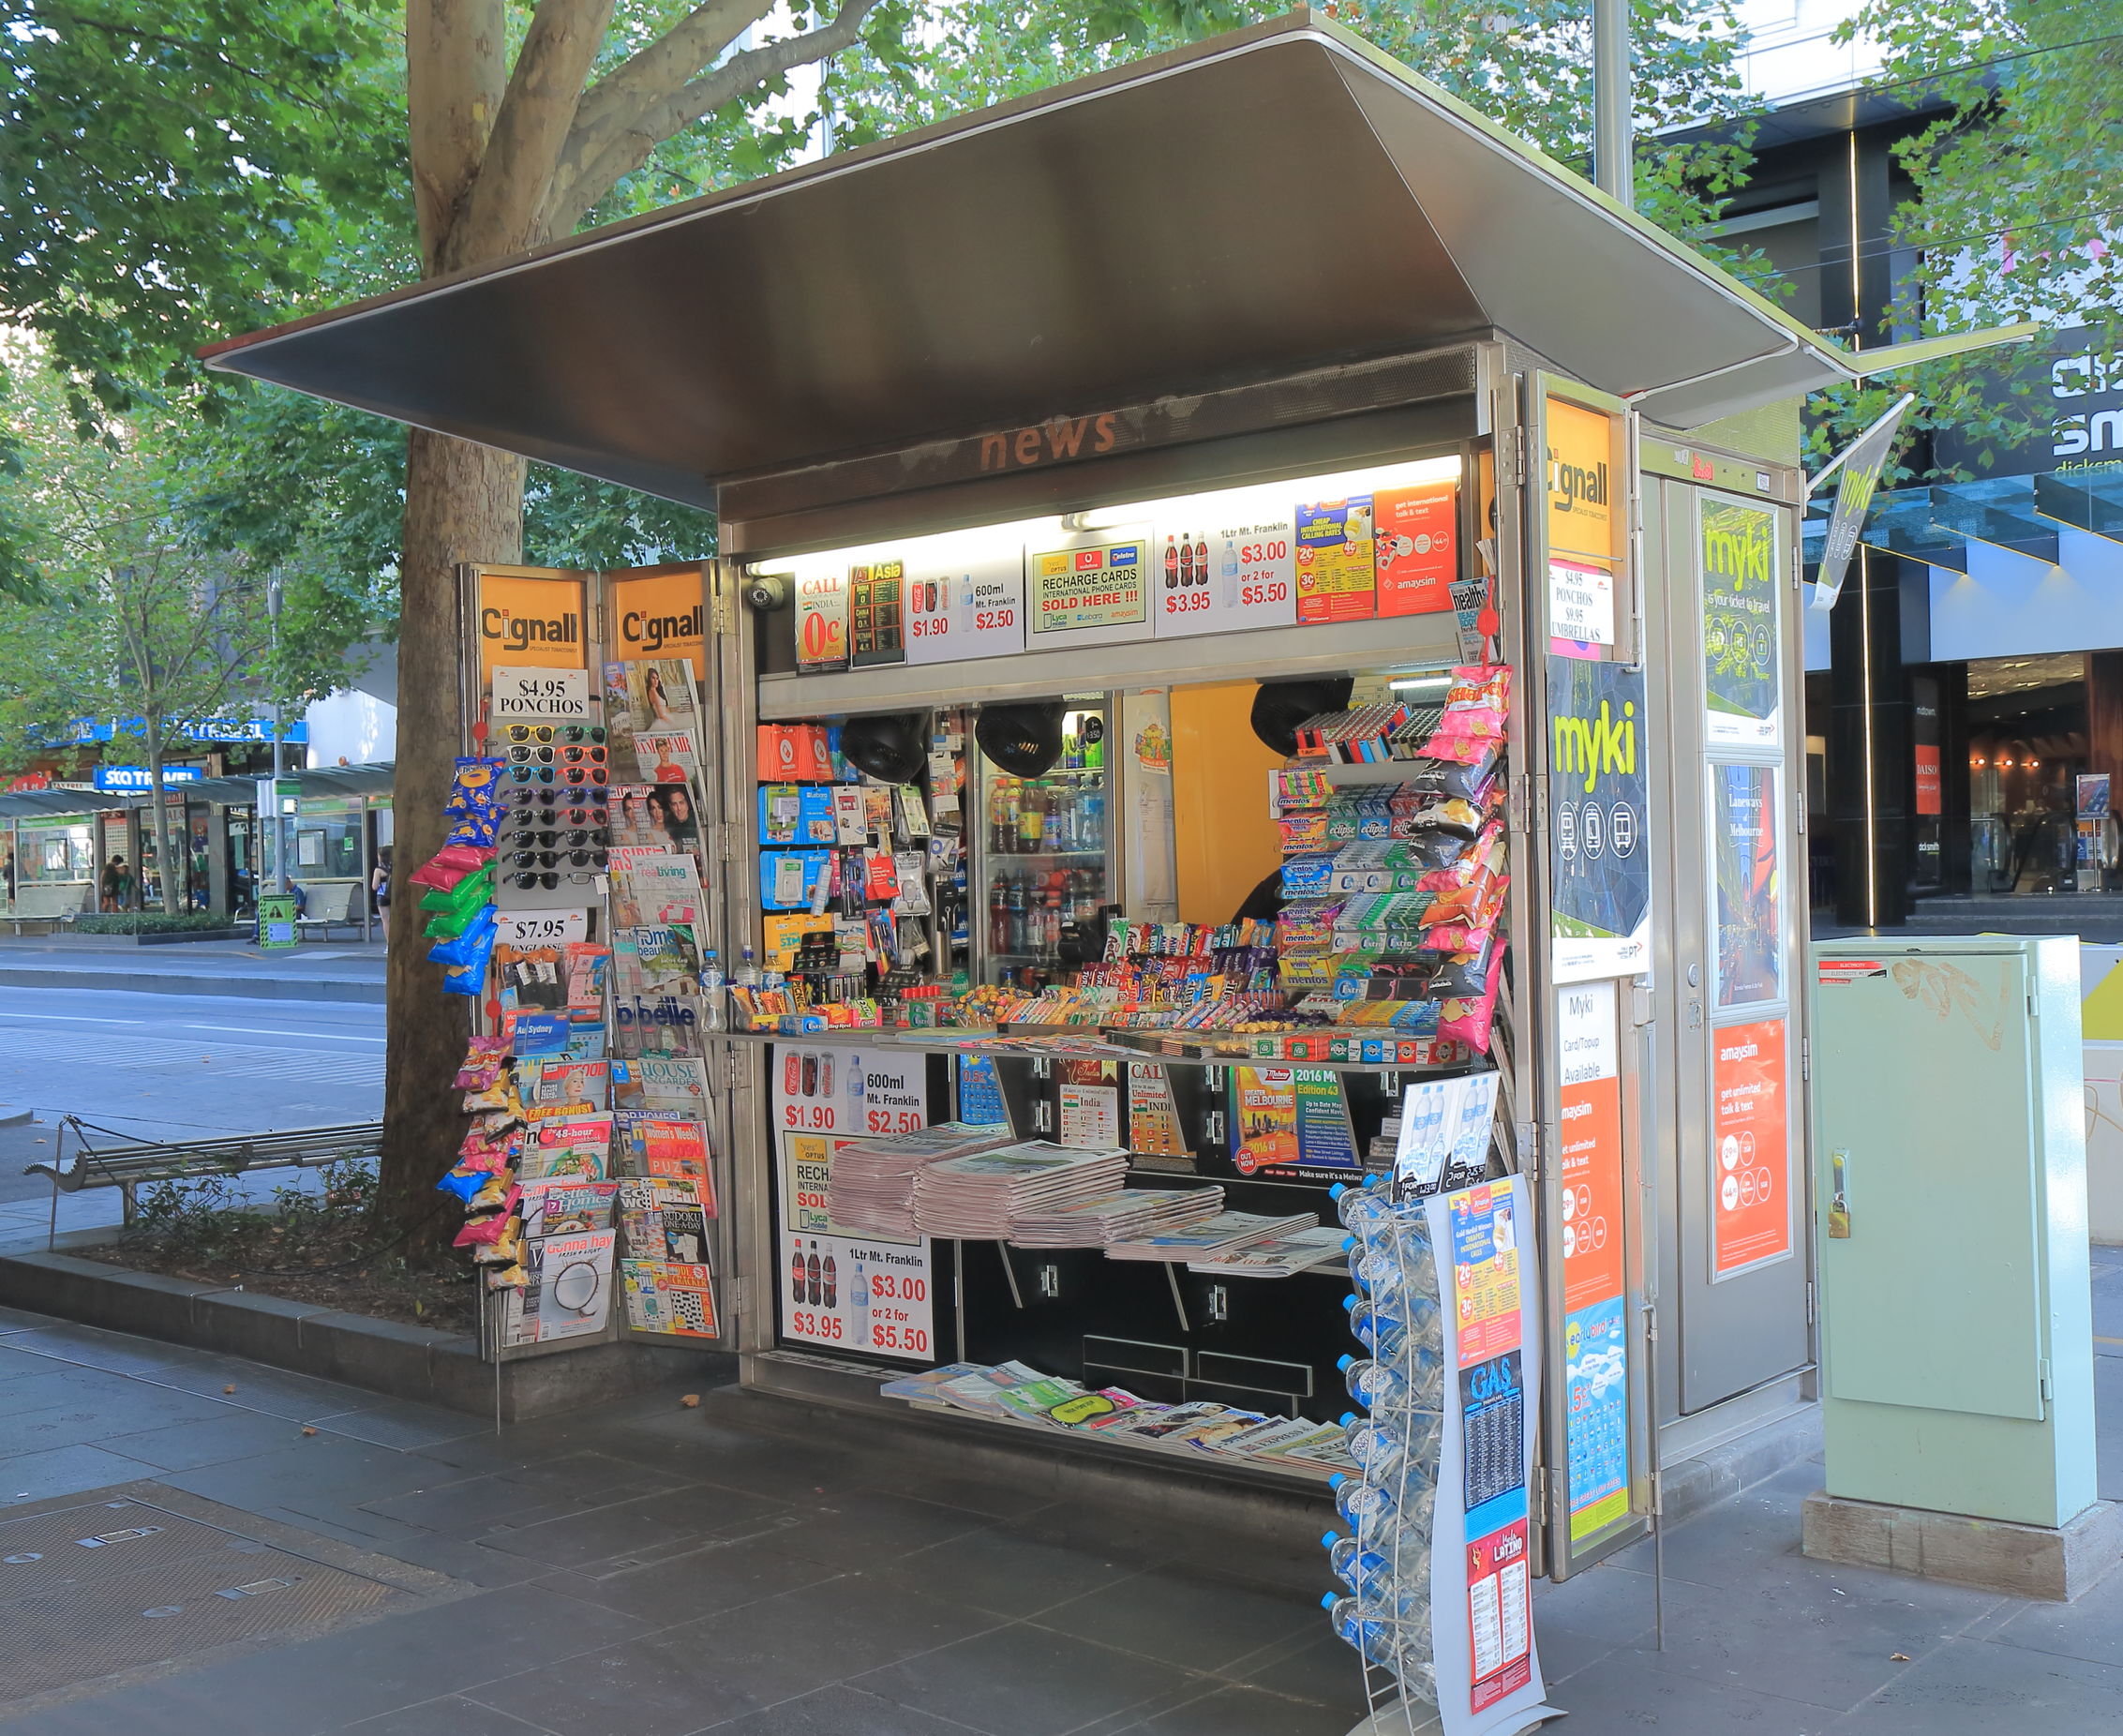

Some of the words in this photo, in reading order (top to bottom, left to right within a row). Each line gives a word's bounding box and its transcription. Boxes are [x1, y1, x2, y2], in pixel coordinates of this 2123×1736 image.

[980, 413, 1116, 471] news
[1407, 495, 1448, 507] international
[1300, 522, 1342, 533] INTERNATIONAL
[1312, 516, 1331, 526] CHEAP
[1220, 530, 1237, 540] 1Ltr
[1239, 527, 1252, 536] Mt.
[1253, 522, 1288, 533] Franklin
[1301, 531, 1324, 540] CALLING
[1324, 529, 1341, 537] RATES
[1241, 540, 1287, 566] $3.00
[1706, 522, 1769, 591] myki
[875, 563, 901, 581] Asia
[1042, 573, 1099, 591] RECHARGE
[1100, 568, 1137, 584] CARDS
[1241, 574, 1251, 582] or
[1253, 571, 1260, 581] 2
[1261, 570, 1275, 580] for
[1565, 569, 1583, 586] $4.95
[802, 576, 842, 595] CALL
[976, 583, 1005, 596] 600ml
[1042, 587, 1090, 599] INTERNATIONAL
[1091, 584, 1114, 593] PHONE
[1114, 581, 1137, 591] CARDS
[1397, 576, 1436, 590] amaysim
[1241, 581, 1287, 606] $5.50
[1556, 587, 1593, 606] PONCHOS
[812, 600, 834, 610] INDIA
[976, 599, 987, 608] Mt.
[988, 597, 1016, 606] Franklin
[1042, 598, 1079, 612] SOLD
[1083, 593, 1121, 607] HERE
[1166, 591, 1211, 615] $3.95
[976, 609, 1014, 631] $2.50
[1565, 606, 1584, 622] $9.95
[482, 607, 577, 651] Cignall
[622, 605, 704, 651] Cignall
[912, 617, 949, 637] $1.90
[1551, 621, 1601, 642] UMBRELLAS
[518, 679, 566, 697] $4.95
[500, 697, 583, 714] PONCHOS
[1554, 699, 1635, 794] myki
[1917, 764, 1937, 774] DAISO
[133, 771, 193, 786] TRVEL
[1279, 797, 1311, 805] mentos
[1728, 792, 1763, 814] Laneways
[1329, 823, 1356, 835] eclipse
[1361, 823, 1387, 835] eclipse
[1728, 822, 1764, 837] Melbourne
[1283, 842, 1314, 851] mentos
[516, 920, 565, 939] $7.95
[1285, 934, 1315, 942] mentos
[1287, 976, 1328, 985] mentos
[1569, 994, 1593, 1019] Myki
[529, 1025, 553, 1034] Sydney
[1563, 1036, 1600, 1052] Card/Topup
[1720, 1040, 1758, 1062] amaysim
[639, 1062, 698, 1079] HOUSE
[1131, 1064, 1163, 1079] CAL
[1296, 1069, 1323, 1082] 2016
[1564, 1062, 1601, 1084] Available
[867, 1073, 905, 1089] 600ml
[1132, 1089, 1167, 1099] Unlimited
[1297, 1084, 1327, 1095] Edition
[1327, 1085, 1338, 1096] 43
[1721, 1088, 1732, 1101] get
[1733, 1081, 1761, 1097] unlimited
[866, 1093, 881, 1104] Mt.
[883, 1094, 919, 1107] Franklin
[1080, 1097, 1101, 1107] India
[1149, 1101, 1171, 1111] INDI
[1245, 1095, 1293, 1107] MELBOURNE
[1741, 1100, 1754, 1112] text
[528, 1107, 553, 1118] FREE
[553, 1103, 593, 1116] BONUS!
[785, 1103, 835, 1130] $1.90
[1561, 1100, 1592, 1121] maysim
[868, 1109, 921, 1134] $2.50
[555, 1128, 594, 1138] 48-hour
[646, 1127, 674, 1139] Women's
[675, 1125, 700, 1142] Weekly
[1569, 1137, 1596, 1153] unlimited
[805, 1151, 825, 1160] OPTUS
[1240, 1152, 1253, 1160] OUT
[1240, 1159, 1255, 1168] NOW
[1577, 1155, 1589, 1166] text
[797, 1164, 832, 1182] RECH
[1342, 1173, 1363, 1181] Melwa
[798, 1181, 830, 1191] INTERNA
[797, 1191, 827, 1208] SOL
[663, 1211, 701, 1222] SUDOKU
[810, 1211, 828, 1223] Lyca
[664, 1220, 702, 1230] ONE-A-DAY
[591, 1235, 613, 1249] hay
[849, 1249, 868, 1262] 1Ltr
[869, 1250, 884, 1263] Mt.
[885, 1252, 923, 1267] Franklin
[672, 1274, 708, 1287] CRACKER
[872, 1274, 926, 1302] $3.00
[872, 1309, 886, 1319] or
[886, 1309, 892, 1320] 2
[893, 1309, 909, 1322] for
[794, 1310, 843, 1339] $3.95
[873, 1324, 928, 1353] $5.50
[1470, 1355, 1512, 1400] GAS
[1493, 1536, 1523, 1563] LATINO
